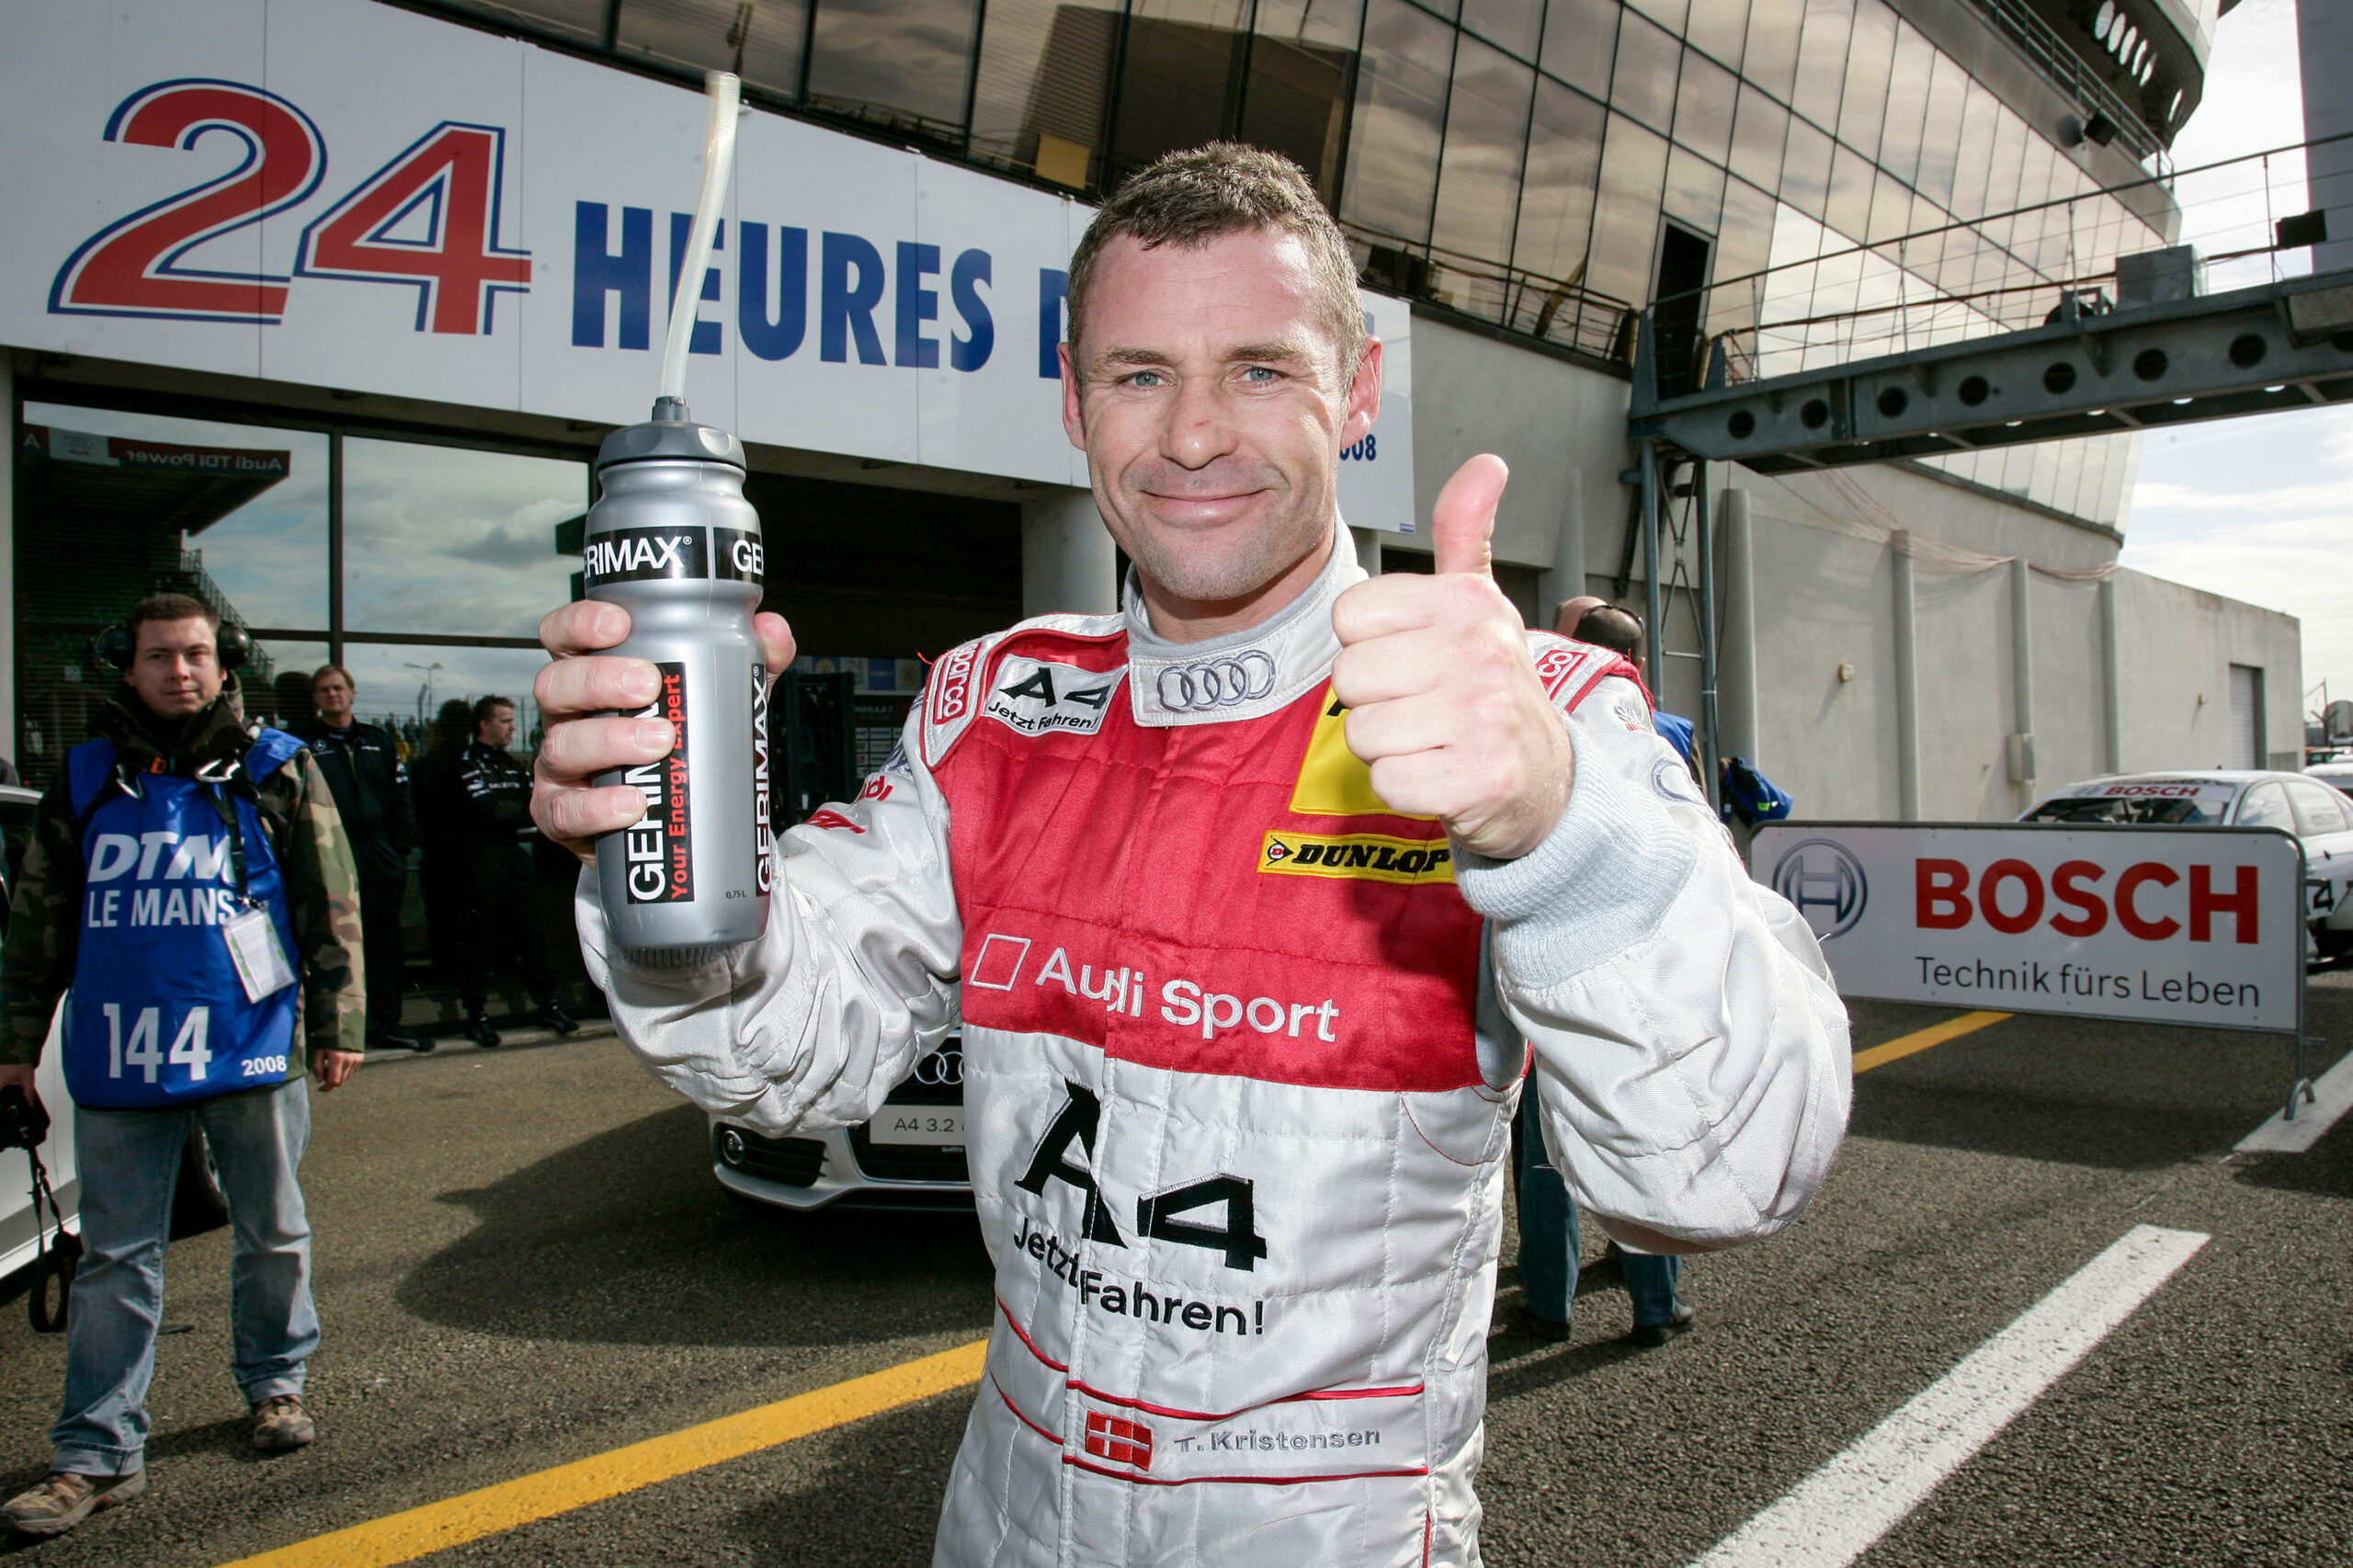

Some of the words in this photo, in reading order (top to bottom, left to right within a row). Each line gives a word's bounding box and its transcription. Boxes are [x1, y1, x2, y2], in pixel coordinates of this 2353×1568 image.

[48, 78, 532, 335] 24
[572, 199, 995, 373] HEURES
[999, 667, 1112, 710] A4
[988, 701, 1035, 731] Jetzt
[1038, 711, 1099, 731] Fahren!
[668, 756, 688, 837] Energy
[2104, 786, 2202, 798] BOSCH
[87, 831, 244, 887] DTM
[671, 843, 688, 900] Your
[1291, 844, 1452, 873] DUNLOP
[88, 890, 120, 928] LE
[131, 888, 237, 927] MANS
[1915, 858, 2258, 945] BOSCH
[1036, 947, 1143, 1017] Audi
[1161, 979, 1340, 1042] Sport
[1915, 956, 2051, 994] Technik
[2060, 963, 2131, 998] fürs
[2143, 970, 2260, 1007] Leben
[103, 1002, 212, 1084] 144
[241, 1054, 288, 1077] 2008
[893, 1118, 920, 1131] A4
[926, 1118, 955, 1132] 3.2
[1014, 1075, 1267, 1272] A4
[1013, 1217, 1081, 1289] Jetzt
[1080, 1269, 1264, 1335] Fahren!
[1211, 1428, 1381, 1453] Kristensen
